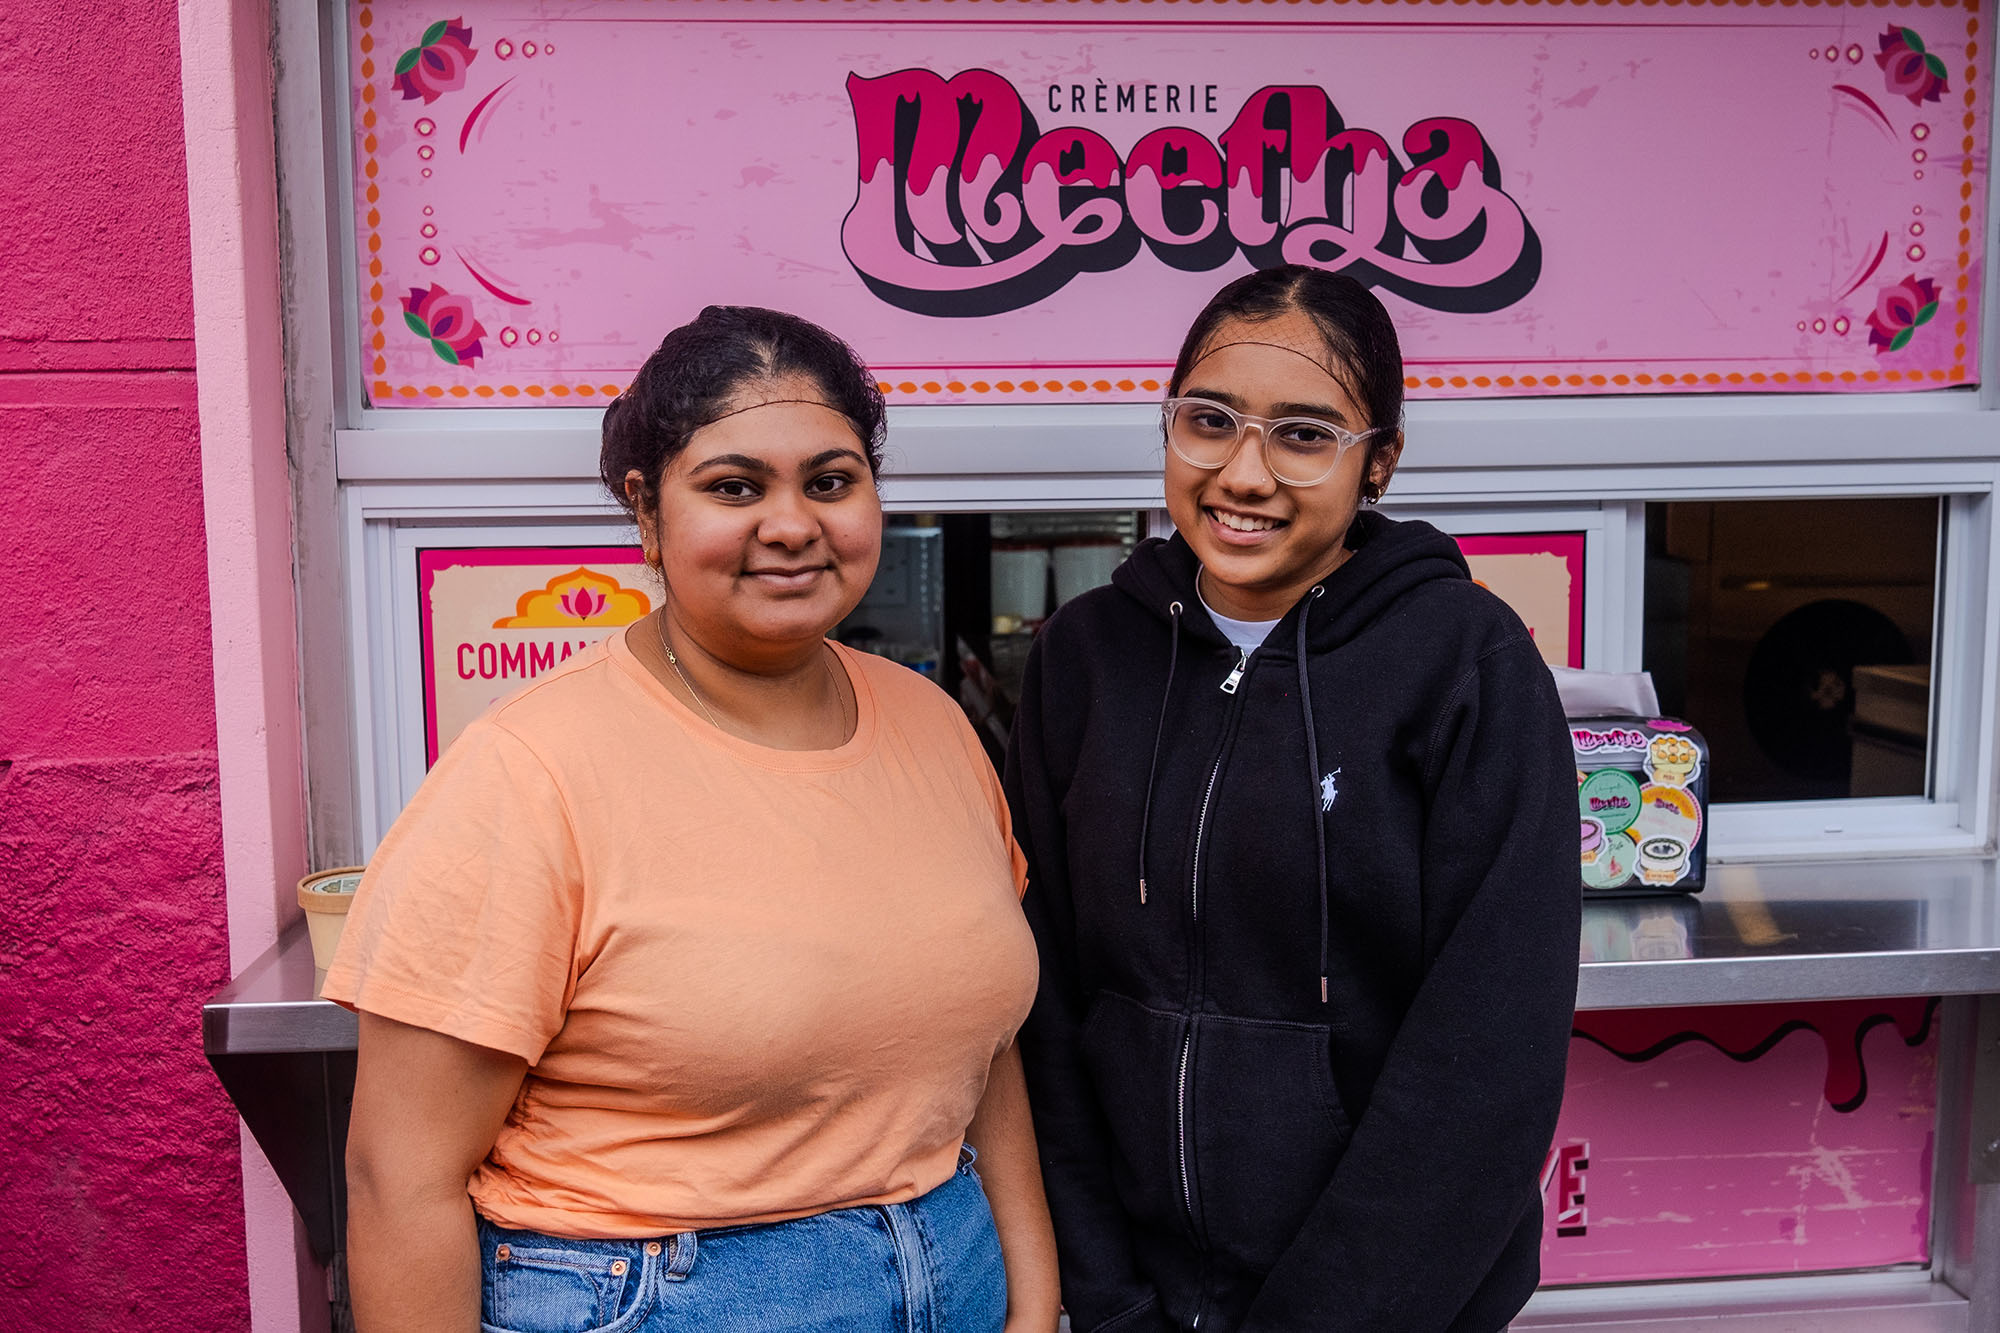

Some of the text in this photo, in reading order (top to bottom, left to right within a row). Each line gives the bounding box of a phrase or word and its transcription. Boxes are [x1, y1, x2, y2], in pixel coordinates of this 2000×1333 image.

[1048, 77, 1218, 113] CRÈMERIE
[841, 67, 1542, 318] Meetha
[457, 641, 599, 680] COMM
